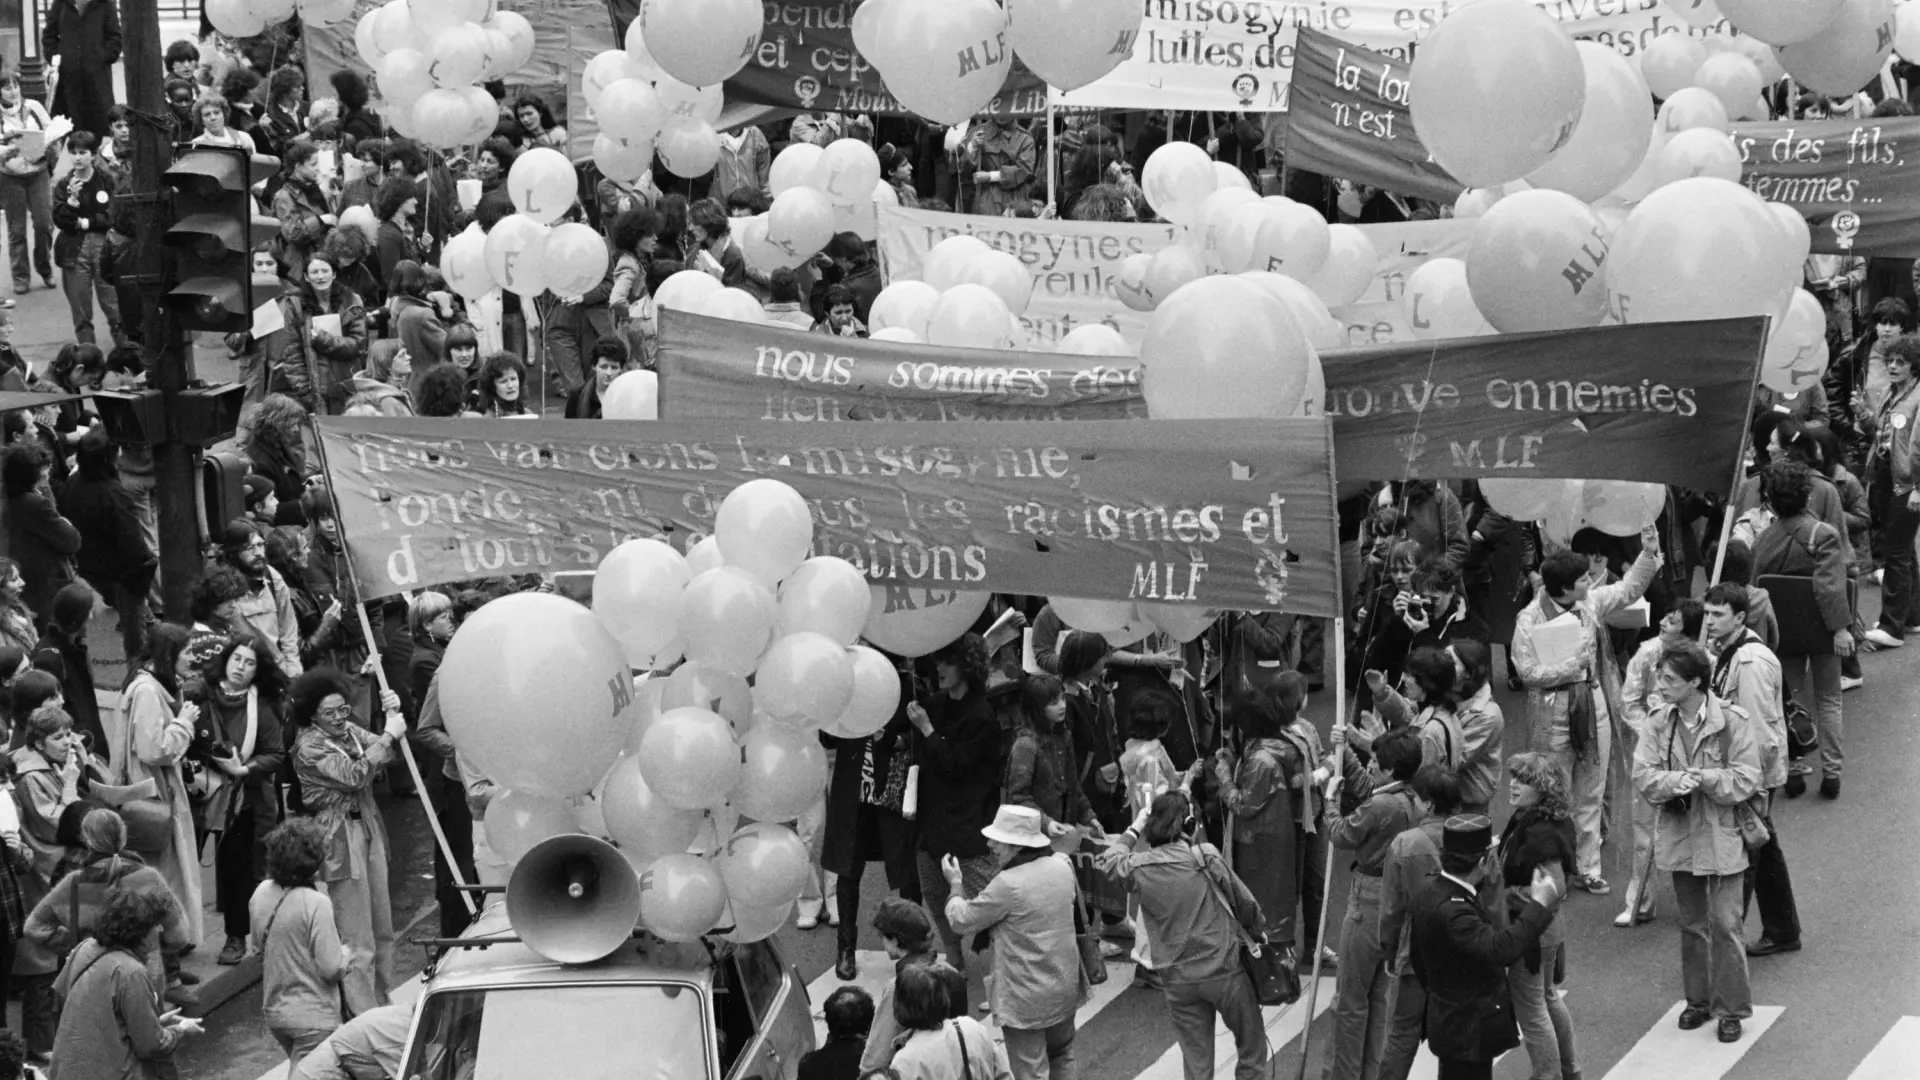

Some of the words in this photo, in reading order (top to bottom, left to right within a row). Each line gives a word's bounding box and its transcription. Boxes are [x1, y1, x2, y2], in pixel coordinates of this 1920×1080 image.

[757, 34, 790, 69] et
[1148, 28, 1244, 69] luttes
[1335, 48, 1361, 91] la
[1330, 101, 1397, 140] n'est
[1771, 128, 1826, 164] des
[1846, 126, 1905, 166] fils,
[754, 345, 855, 386] nous
[887, 360, 1052, 398] sommes
[1449, 435, 1544, 470] MLF
[1004, 498, 1224, 544] racismes
[1241, 491, 1288, 545] et
[1128, 560, 1209, 600] MLF
